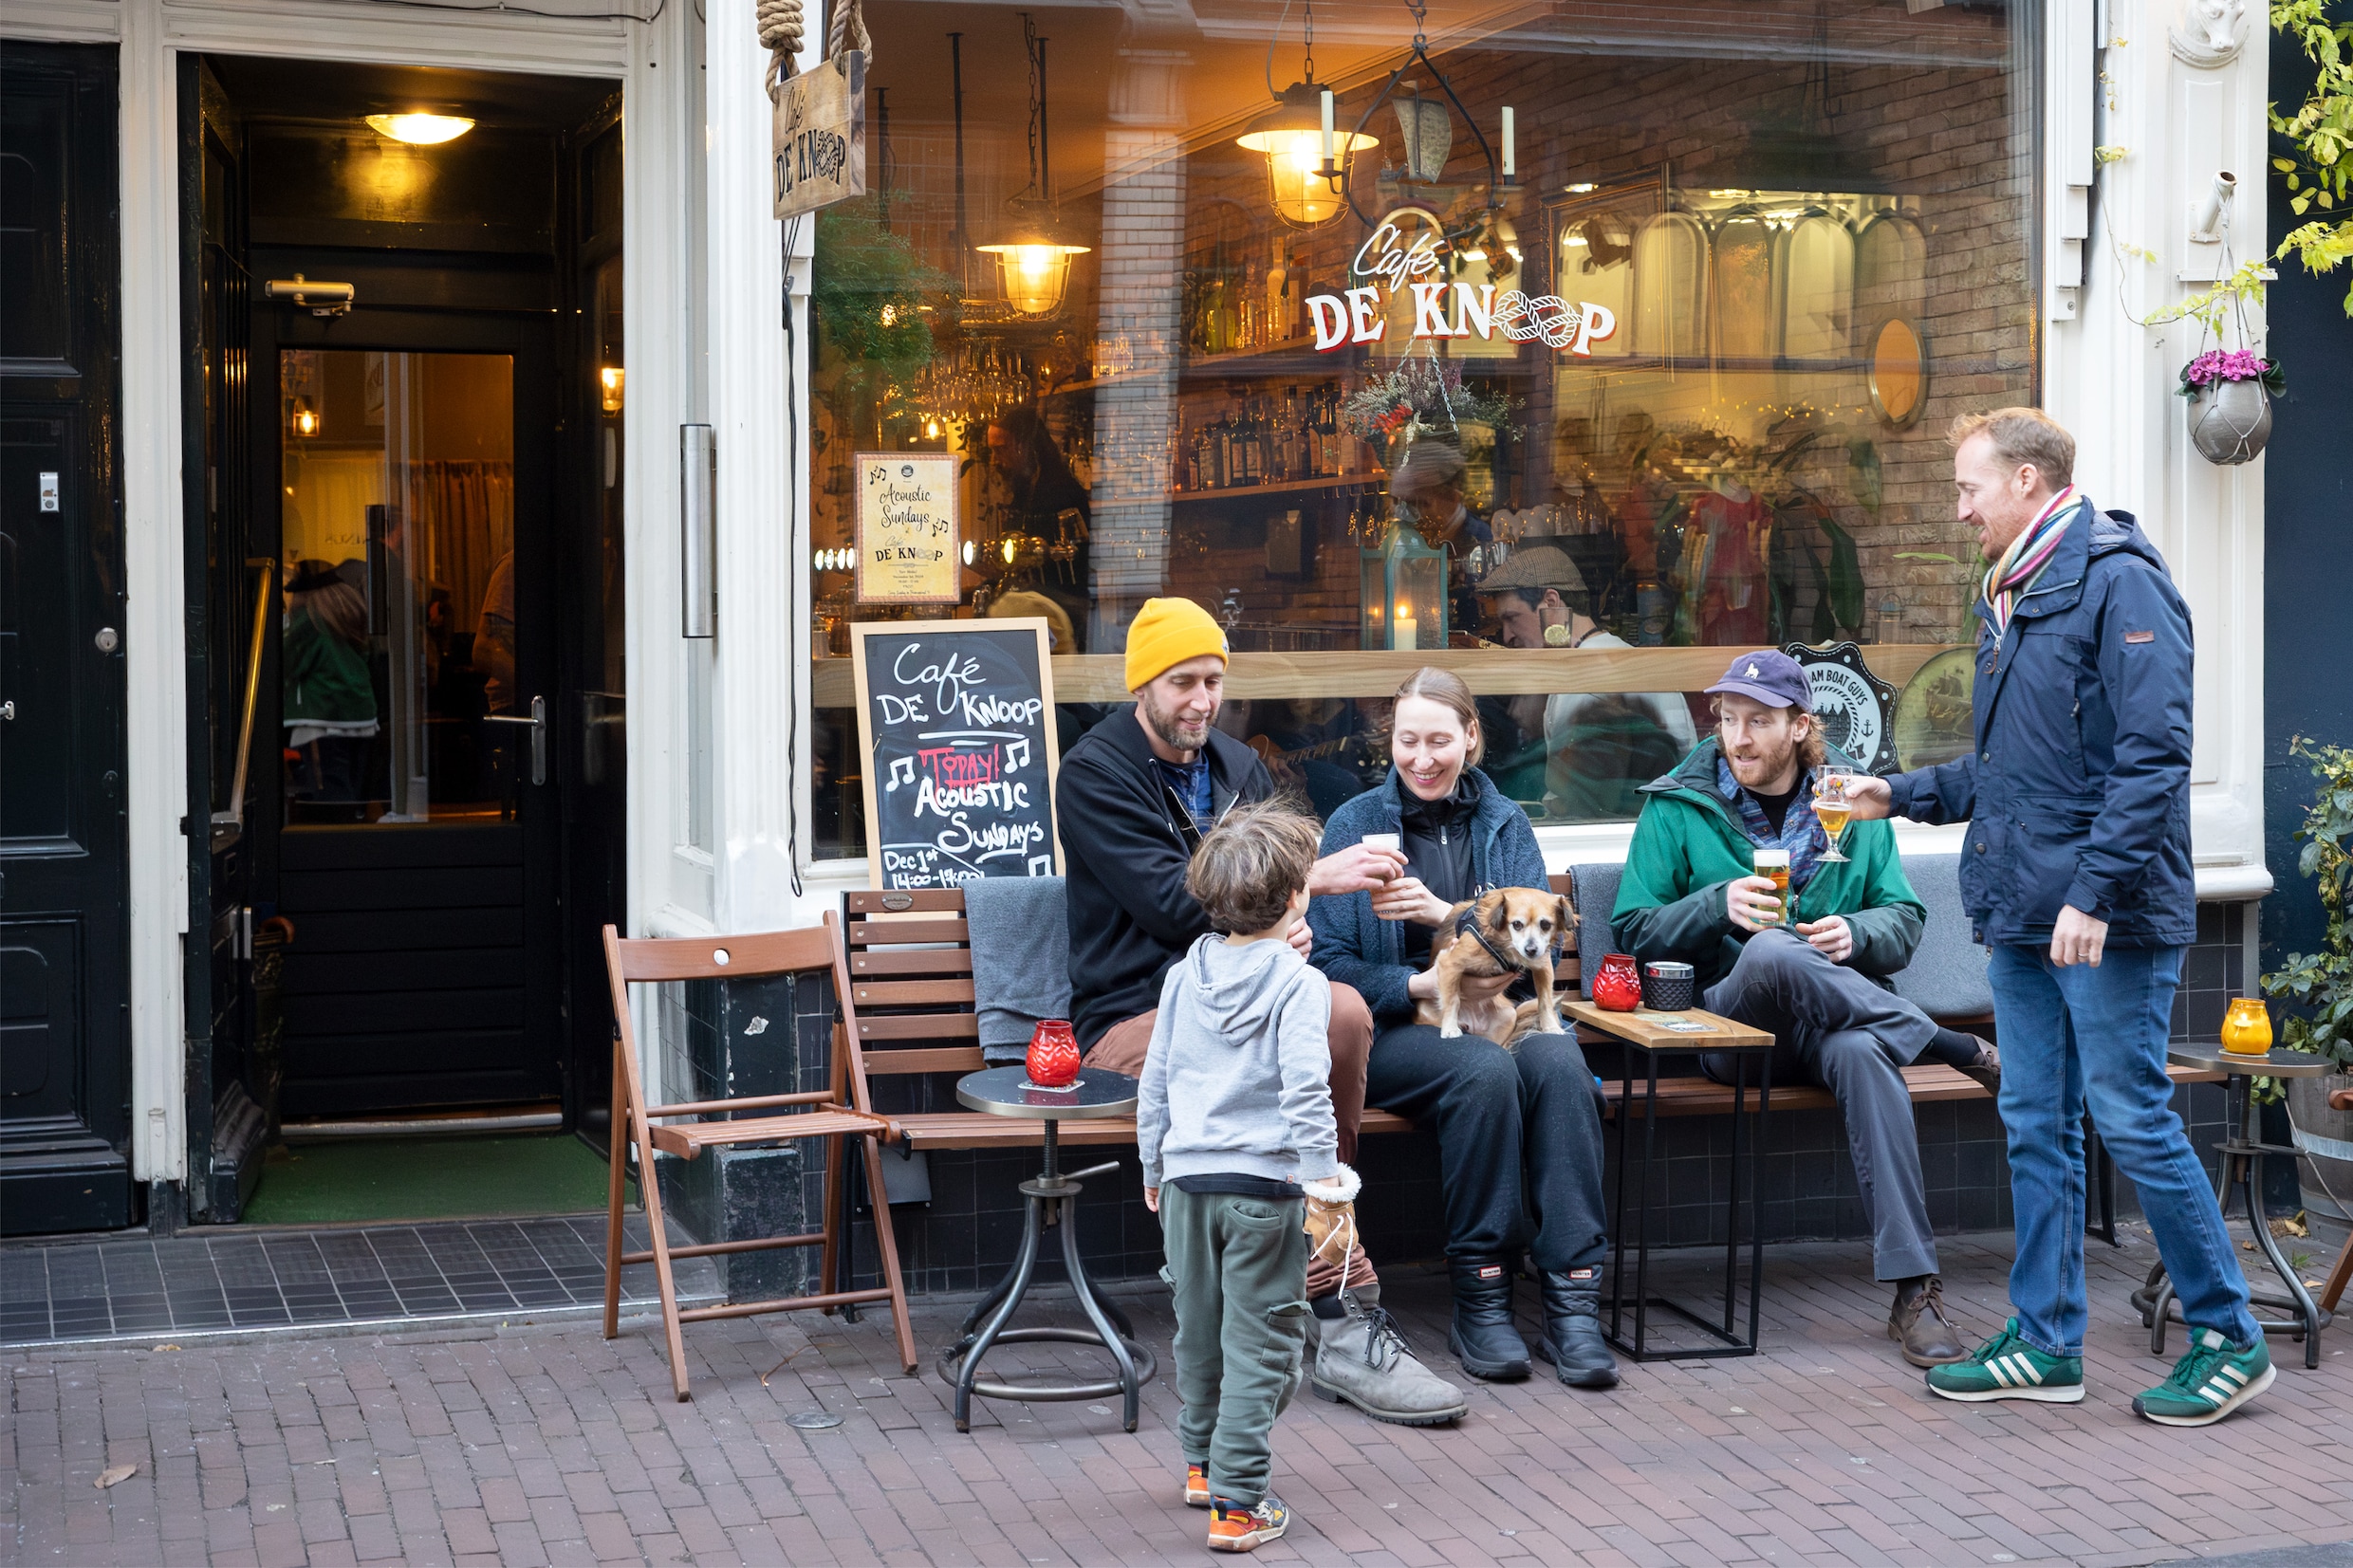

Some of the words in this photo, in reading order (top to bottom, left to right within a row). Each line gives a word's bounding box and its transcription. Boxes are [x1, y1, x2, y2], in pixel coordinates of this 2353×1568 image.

[776, 142, 793, 203] DE
[1353, 223, 1445, 293] Café
[1305, 286, 1387, 353] DE
[1409, 283, 1617, 359] KNOOP
[880, 483, 932, 506] Acoustic
[881, 505, 930, 532] Sundays
[875, 548, 892, 562] DE
[894, 643, 986, 715] Café
[1808, 670, 1824, 683] AM
[1826, 670, 1849, 687] BOAT
[1847, 681, 1868, 706] GUYS
[876, 693, 929, 725] DE
[959, 692, 1043, 727] KNOOP
[883, 851, 917, 872] Dec
[917, 849, 938, 873] 1st
